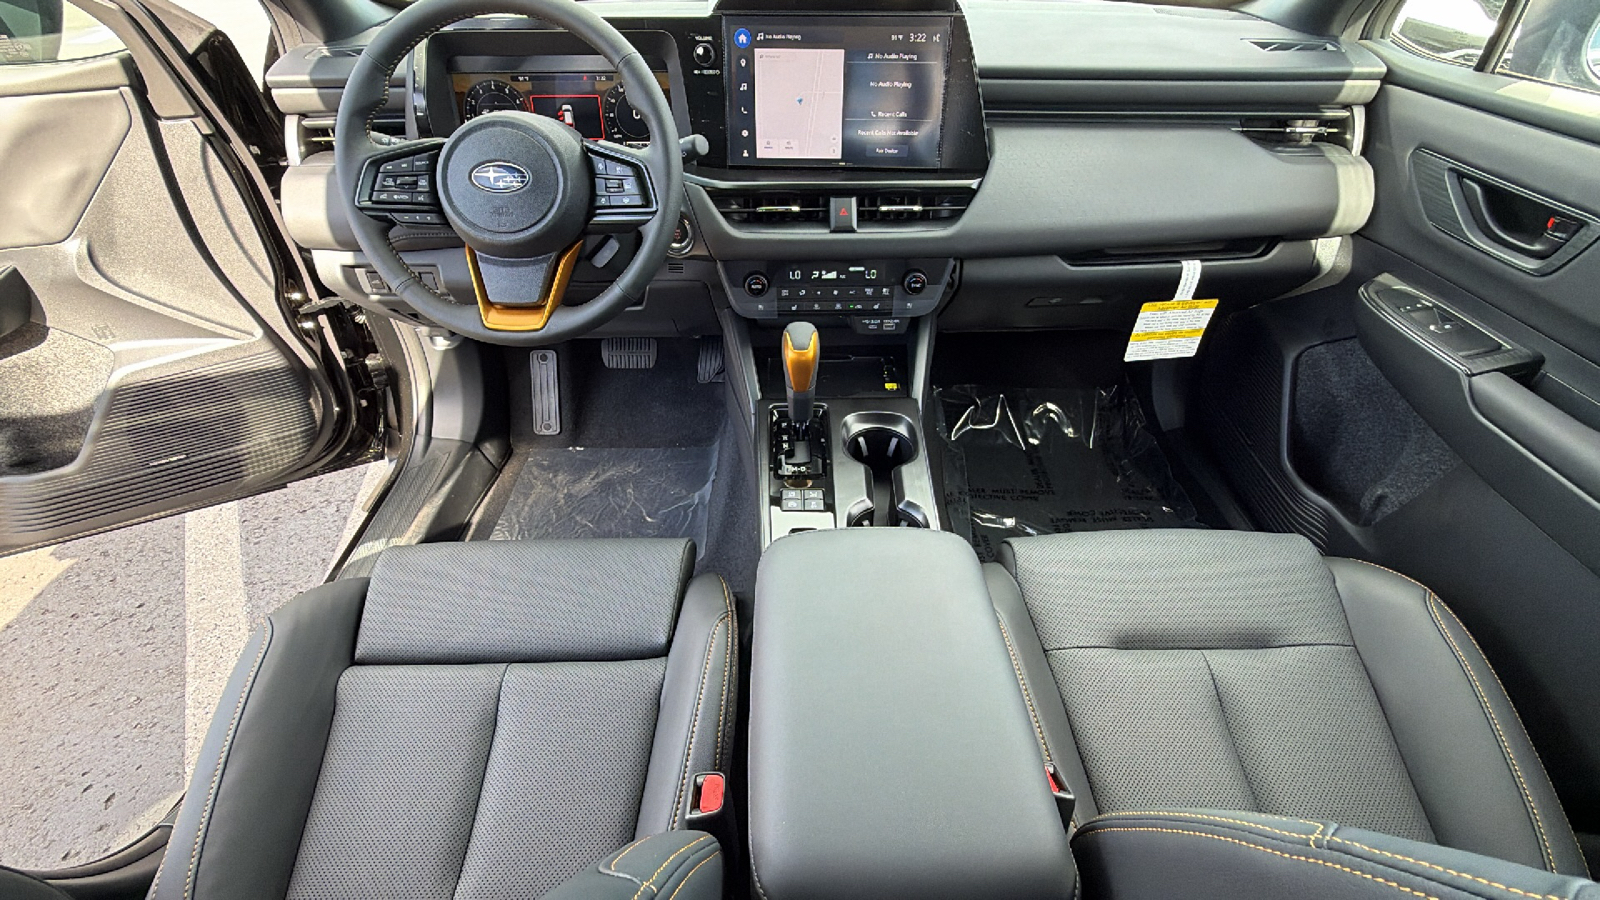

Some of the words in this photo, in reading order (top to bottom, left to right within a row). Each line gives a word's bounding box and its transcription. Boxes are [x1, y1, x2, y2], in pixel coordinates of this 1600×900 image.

[909, 33, 926, 42] 3:22
[893, 81, 912, 89] Playing
[865, 269, 877, 279] LO
